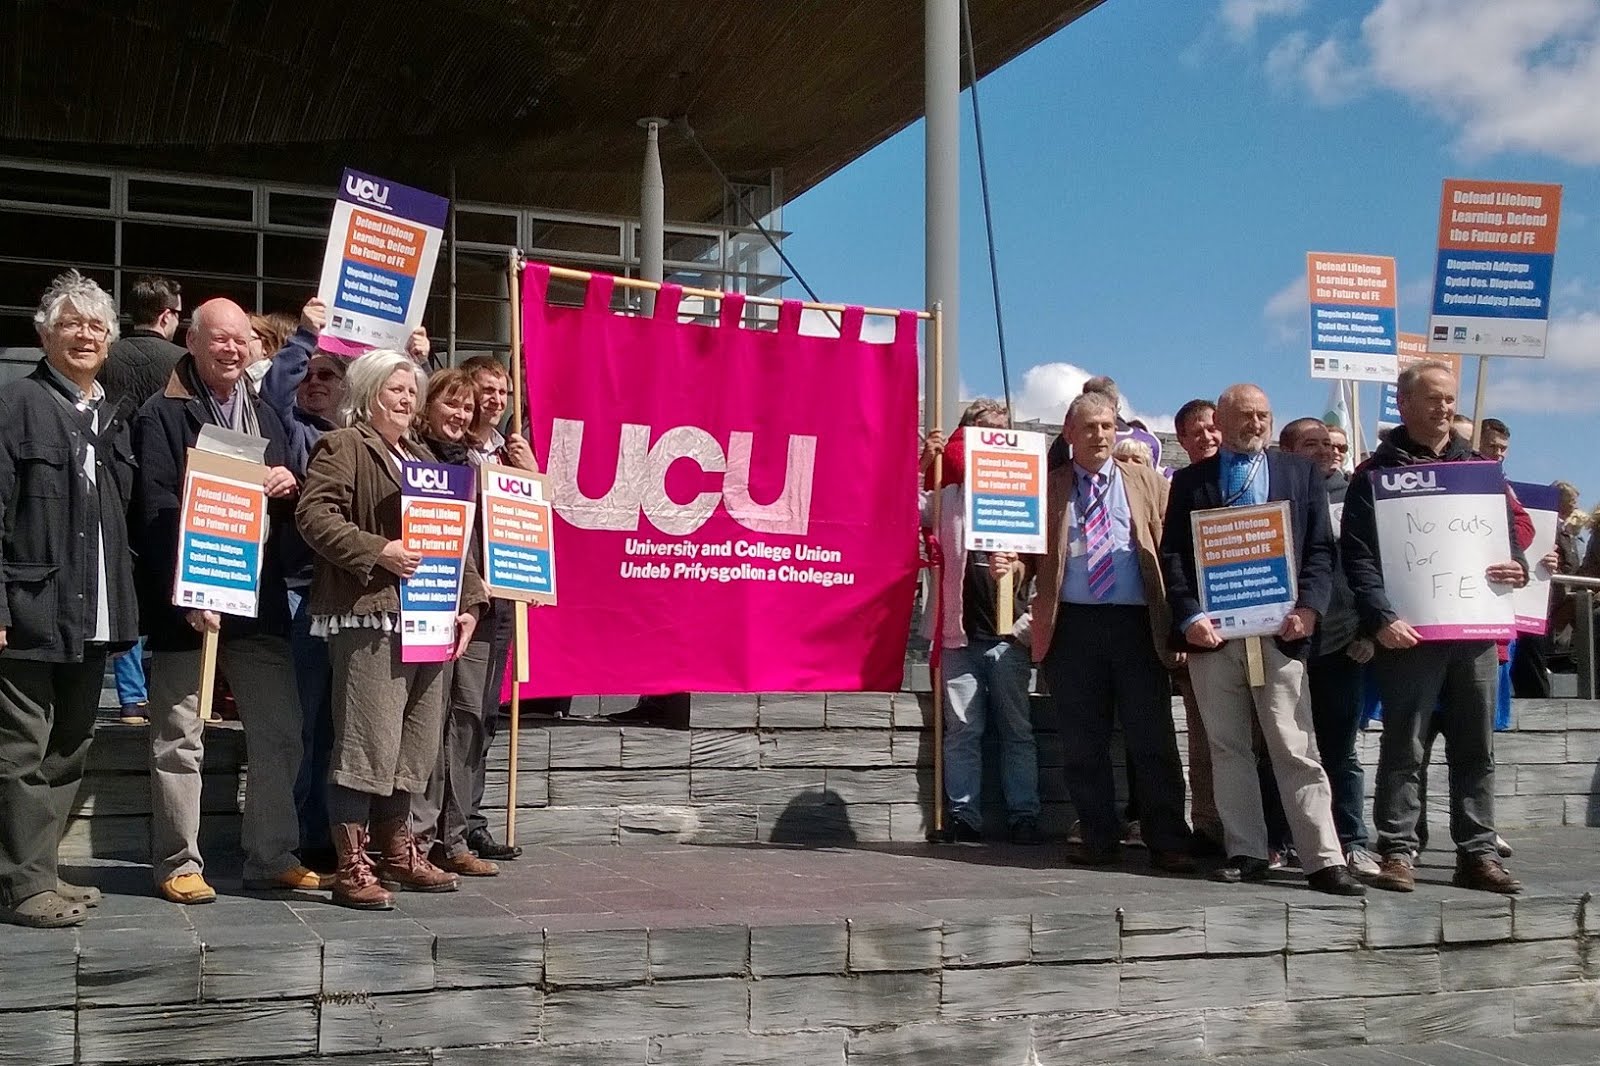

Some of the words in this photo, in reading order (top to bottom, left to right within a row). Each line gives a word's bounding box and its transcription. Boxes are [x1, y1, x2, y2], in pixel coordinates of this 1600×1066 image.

[1454, 191, 1495, 205] Defend
[1496, 192, 1542, 208] Lifelong
[1507, 212, 1547, 226] Defend
[356, 216, 382, 232] Defend
[382, 224, 414, 242] Lifelong
[1450, 228, 1469, 241] the
[1471, 229, 1508, 243] Future
[1509, 232, 1522, 244] of
[1523, 232, 1535, 244] FE
[350, 244, 362, 254] the
[363, 247, 386, 262] Future
[387, 256, 395, 266] of
[396, 257, 406, 268] FE
[387, 240, 416, 256] Defend
[1316, 262, 1346, 271] Defend
[1348, 263, 1381, 275] Lifelong
[1358, 277, 1387, 287] Defend
[1317, 289, 1331, 297] the
[1333, 289, 1360, 299] Future
[1361, 291, 1369, 300] of
[1371, 291, 1380, 300] FE
[197, 487, 222, 501] Defend
[222, 492, 250, 508] Lifelong
[229, 508, 254, 522] Defend
[193, 516, 205, 527] the
[206, 518, 230, 531] Future
[230, 524, 238, 533] of
[239, 524, 246, 534] FE
[1203, 522, 1233, 534] Defend
[1235, 518, 1270, 530] Lifelong
[1407, 512, 1435, 534] No
[1449, 515, 1492, 536] cuts
[1246, 529, 1277, 542] Defend
[625, 538, 700, 558] University
[701, 540, 732, 556] and
[734, 540, 791, 562] College
[795, 544, 841, 562] Union
[1206, 552, 1220, 560] the
[1222, 547, 1250, 558] Future
[1251, 545, 1260, 554] of
[1262, 544, 1271, 552] FE
[620, 562, 671, 579] Undeb
[673, 562, 766, 582] Prifysgolion
[767, 569, 776, 580] a
[778, 566, 854, 587] Cholegau
